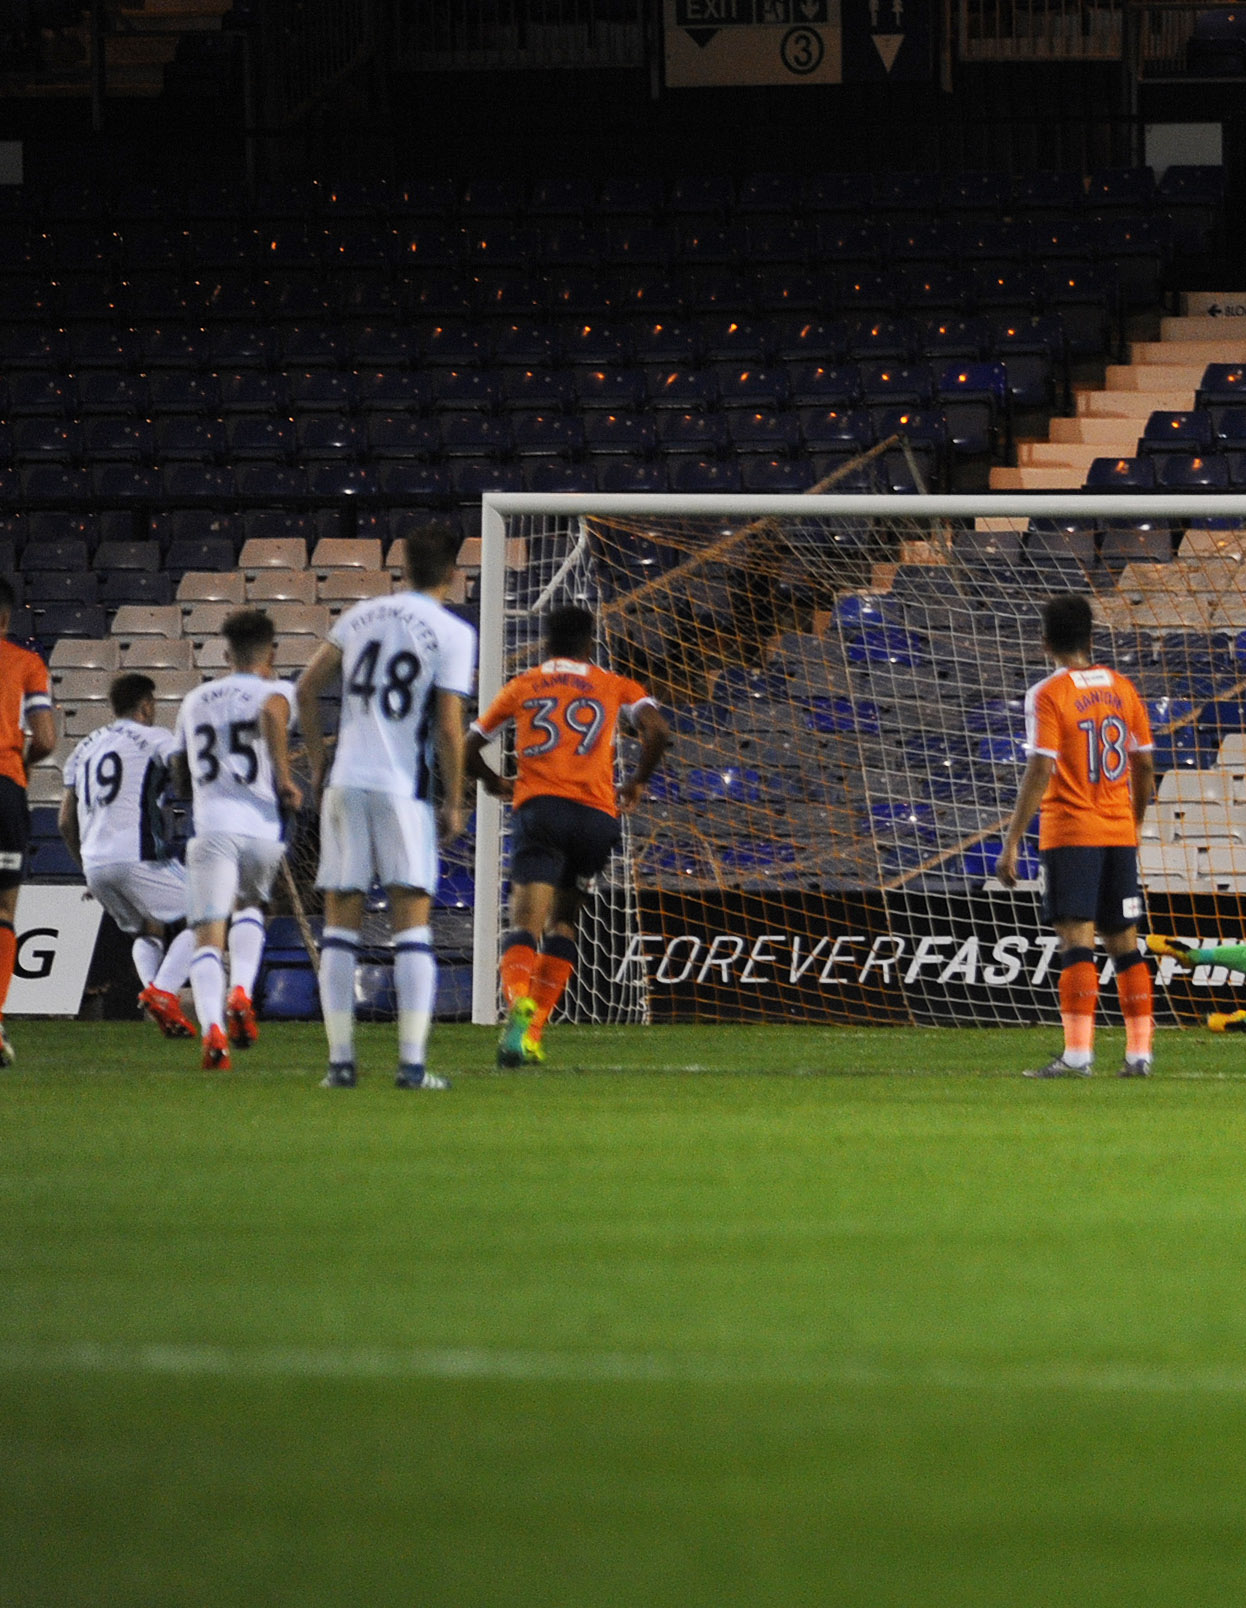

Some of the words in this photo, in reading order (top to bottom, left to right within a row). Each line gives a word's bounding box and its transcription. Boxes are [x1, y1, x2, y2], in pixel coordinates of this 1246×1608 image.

[686, 0, 738, 19] EXIT
[793, 34, 812, 67] 3
[349, 639, 422, 721] 48
[194, 719, 261, 786] 35
[522, 696, 605, 757] 39
[1077, 714, 1128, 784] 18
[84, 750, 123, 813] 19
